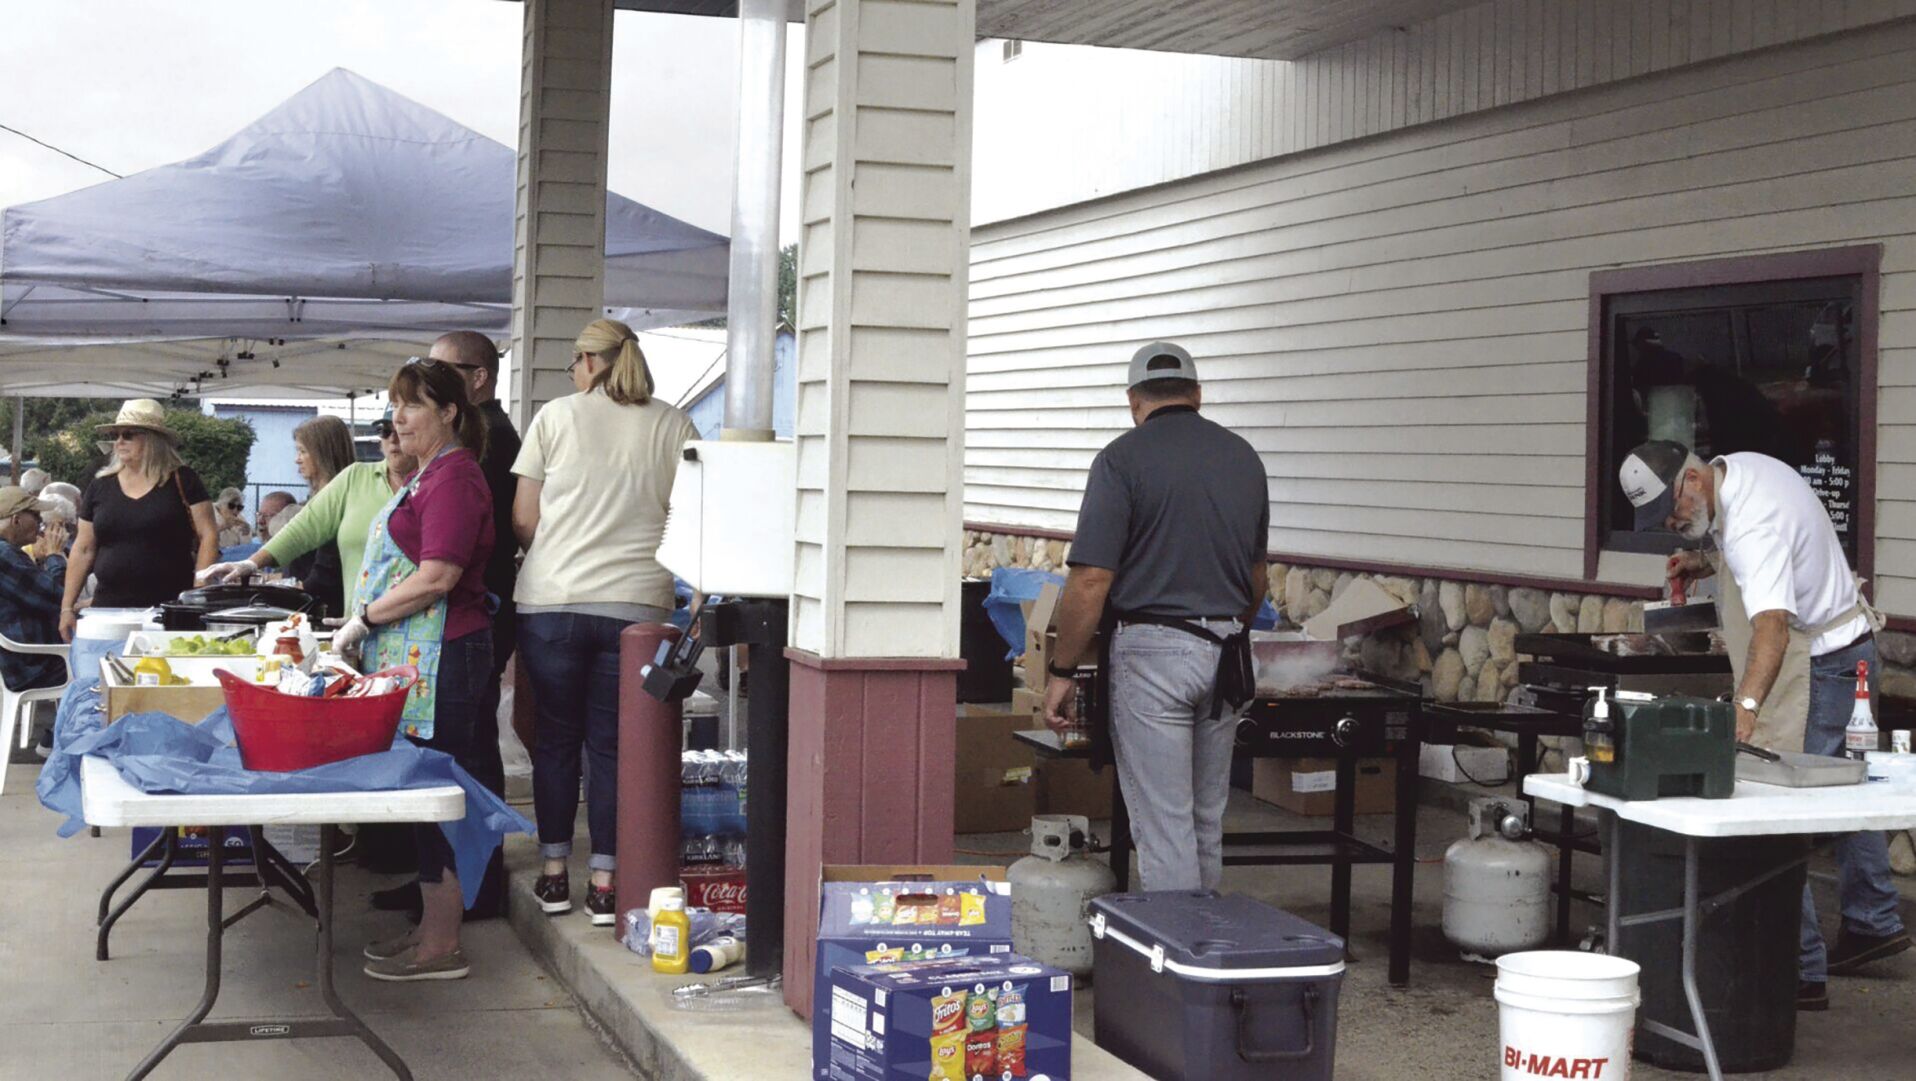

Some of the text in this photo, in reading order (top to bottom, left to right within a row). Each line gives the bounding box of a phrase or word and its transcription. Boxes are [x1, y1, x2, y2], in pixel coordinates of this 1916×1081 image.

[1815, 453, 1835, 465] Lobby
[1801, 465, 1825, 476] Monday
[1829, 477, 1843, 486] 5:00
[1828, 499, 1850, 509] Thurs
[1830, 511, 1844, 520] 5:00
[1270, 731, 1325, 739] BLACKSTONE
[703, 881, 747, 906] Coca-C
[935, 1000, 961, 1022] Fritos
[967, 1042, 992, 1052] Doritos
